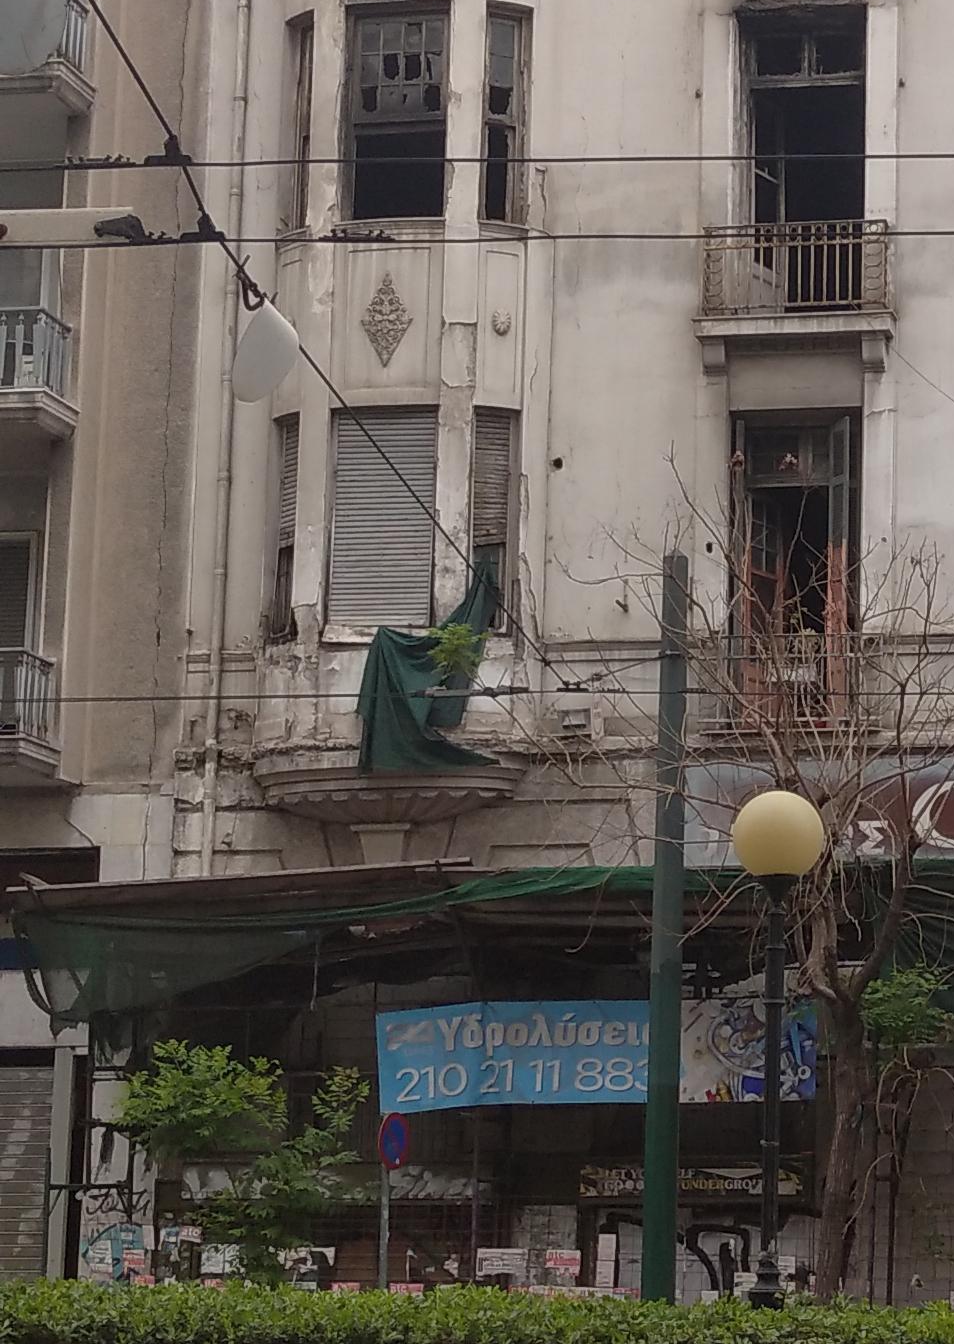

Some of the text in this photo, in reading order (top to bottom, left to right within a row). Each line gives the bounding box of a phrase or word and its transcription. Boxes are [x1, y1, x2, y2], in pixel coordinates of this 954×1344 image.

[395, 1061, 469, 1103] 210
[479, 1058, 515, 1094] 21
[529, 1058, 562, 1093] 11
[681, 1179, 758, 1191] UNDERGRO
